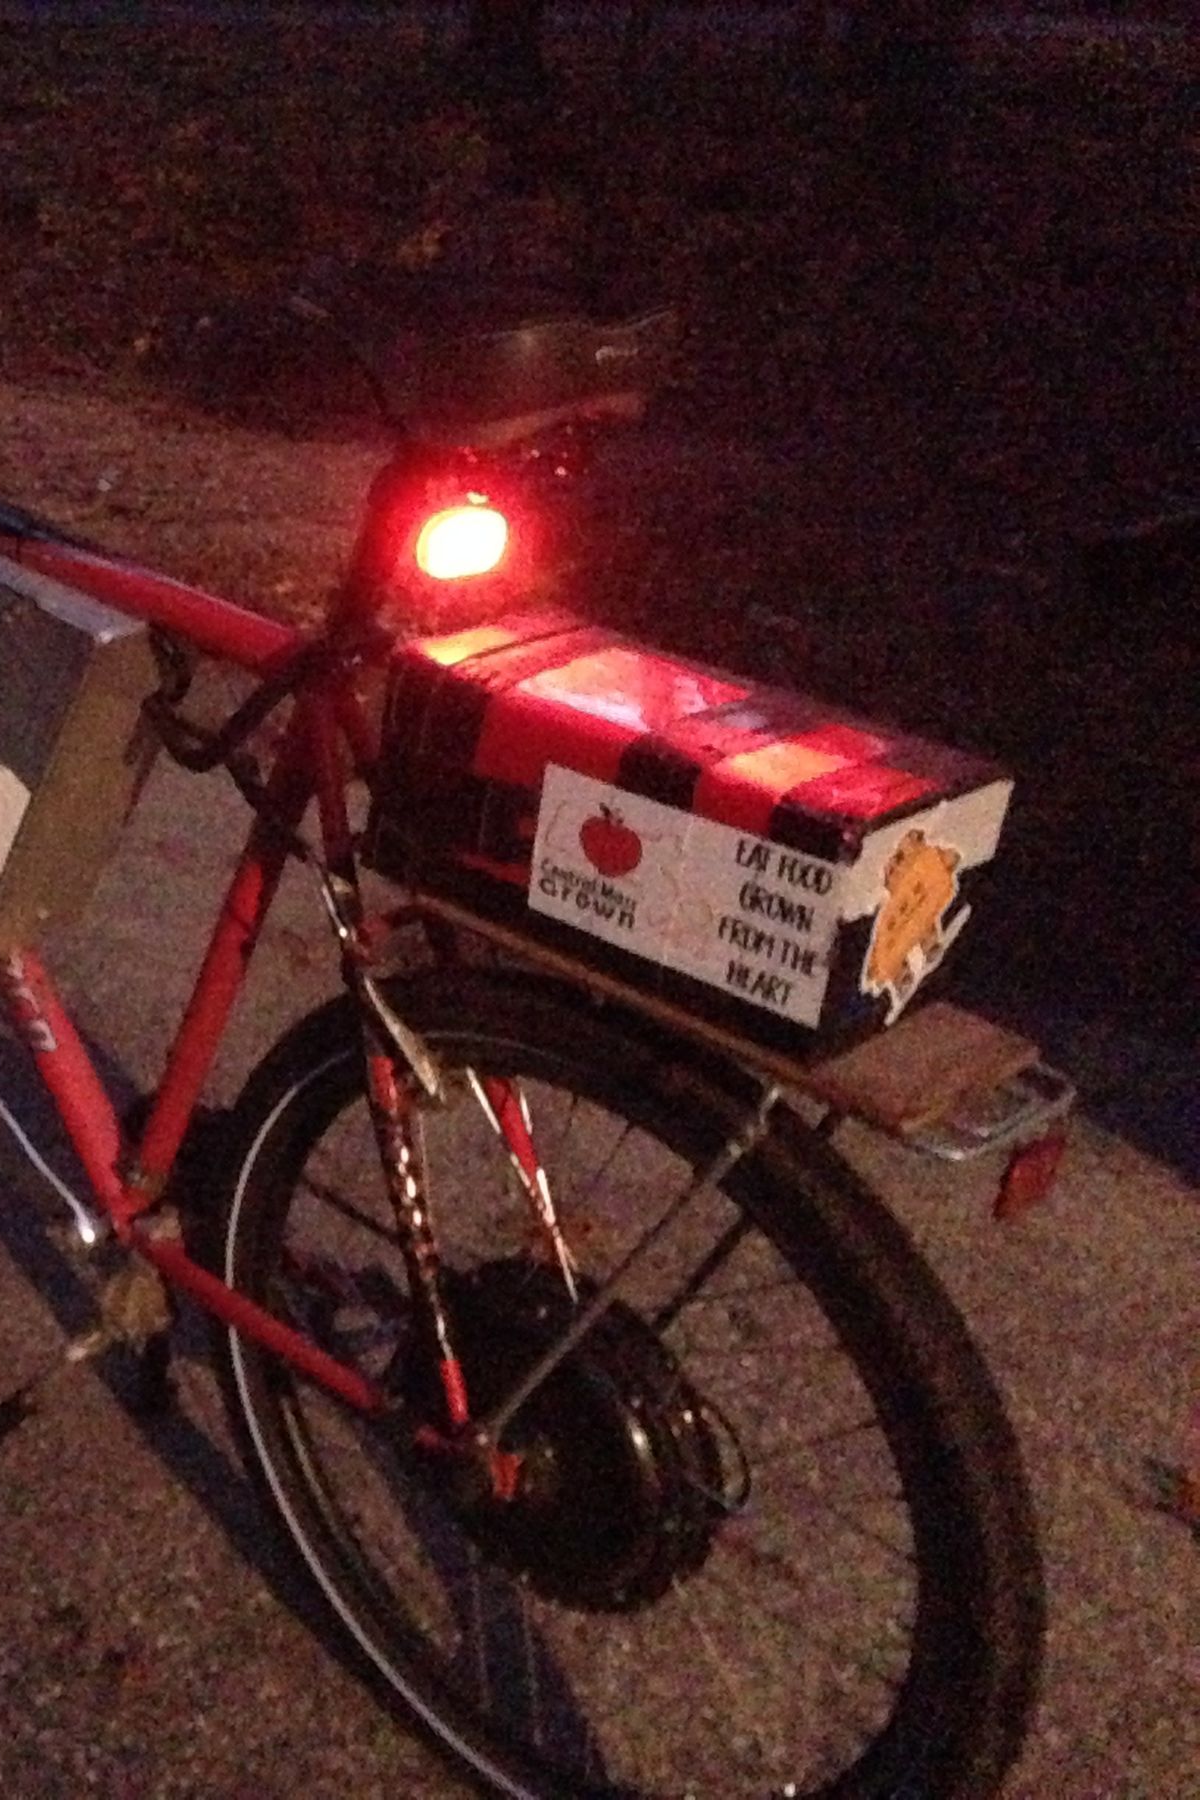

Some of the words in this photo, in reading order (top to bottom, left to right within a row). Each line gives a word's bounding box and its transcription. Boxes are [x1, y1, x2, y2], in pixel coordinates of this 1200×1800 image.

[735, 838, 771, 872] EAT
[776, 854, 833, 895] FOOD
[738, 880, 815, 932] GROWN
[717, 916, 775, 959] FROM
[781, 938, 818, 978] THE
[725, 959, 793, 1006] HEART
